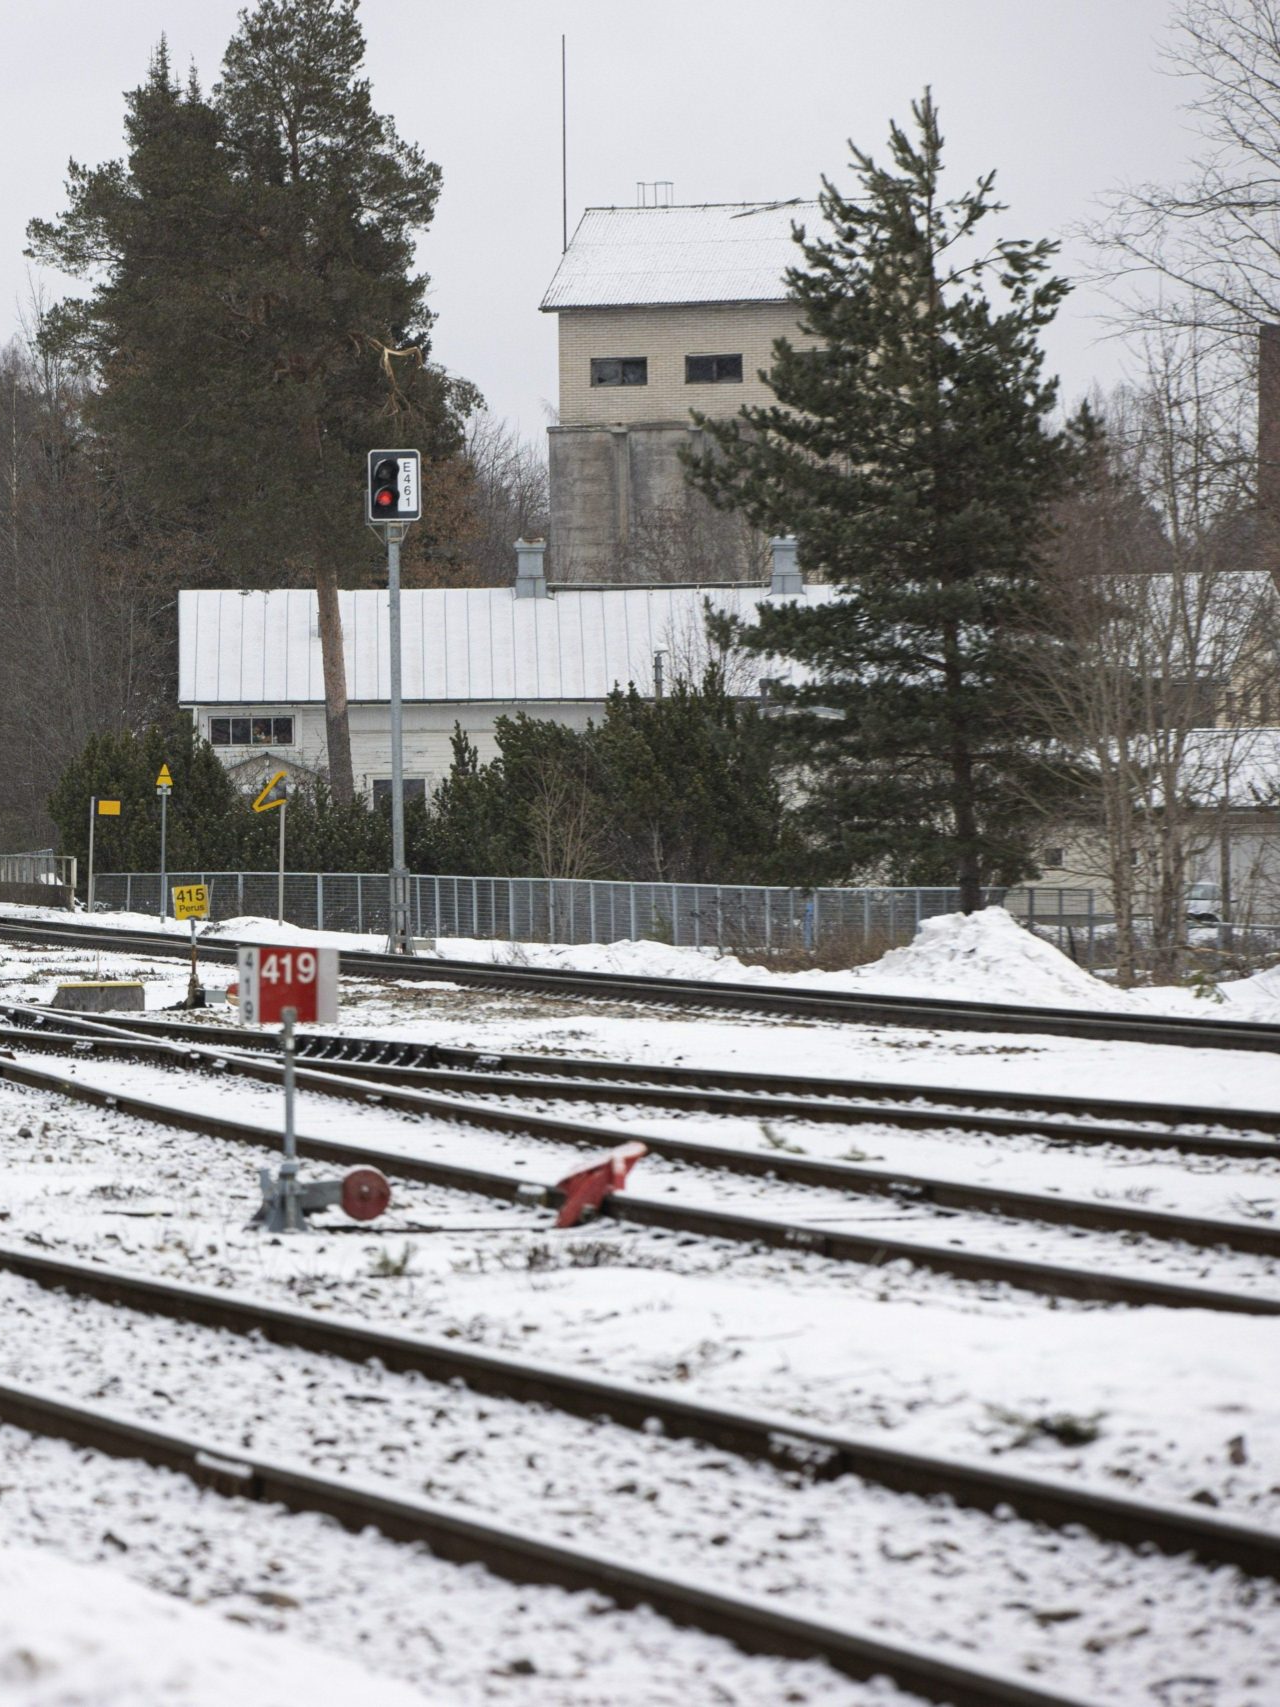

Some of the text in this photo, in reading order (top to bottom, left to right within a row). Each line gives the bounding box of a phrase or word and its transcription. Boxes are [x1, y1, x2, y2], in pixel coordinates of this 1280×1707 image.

[402, 461, 412, 508] E461
[176, 888, 205, 903] 415
[244, 951, 254, 1022] 419
[261, 952, 316, 985] 419
